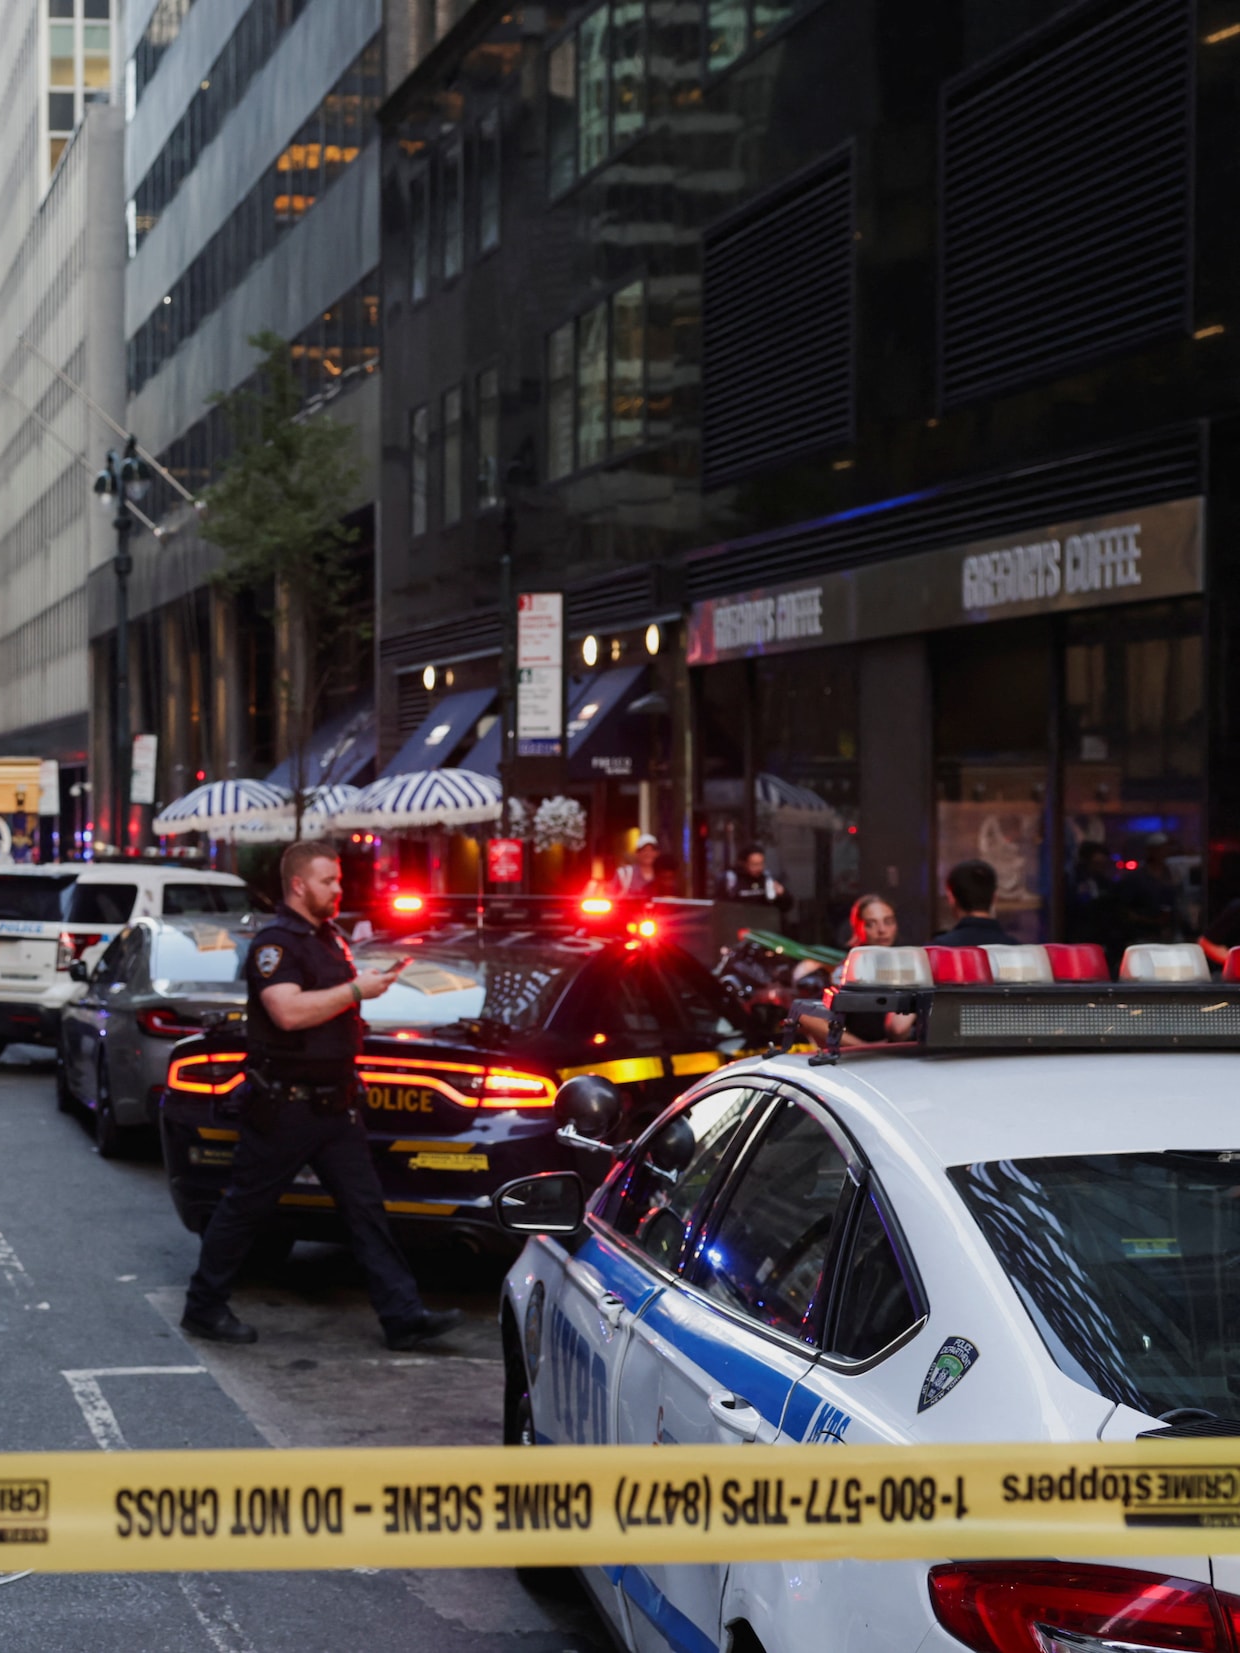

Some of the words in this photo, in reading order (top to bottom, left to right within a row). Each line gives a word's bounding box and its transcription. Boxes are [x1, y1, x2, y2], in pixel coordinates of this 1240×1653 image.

[1065, 524, 1141, 593] COFFEE
[367, 1086, 435, 1113] OLICE
[940, 1345, 972, 1369] DEPARTMENT
[953, 1338, 974, 1354] POLICE
[115, 1487, 218, 1538] CROSS
[230, 1487, 291, 1537] NOT
[301, 1486, 344, 1535] DO
[383, 1484, 483, 1535] SCENE
[495, 1482, 592, 1532] CRIME
[615, 1476, 711, 1533] (8477)
[722, 1475, 967, 1526] 1-800-577-TIPS
